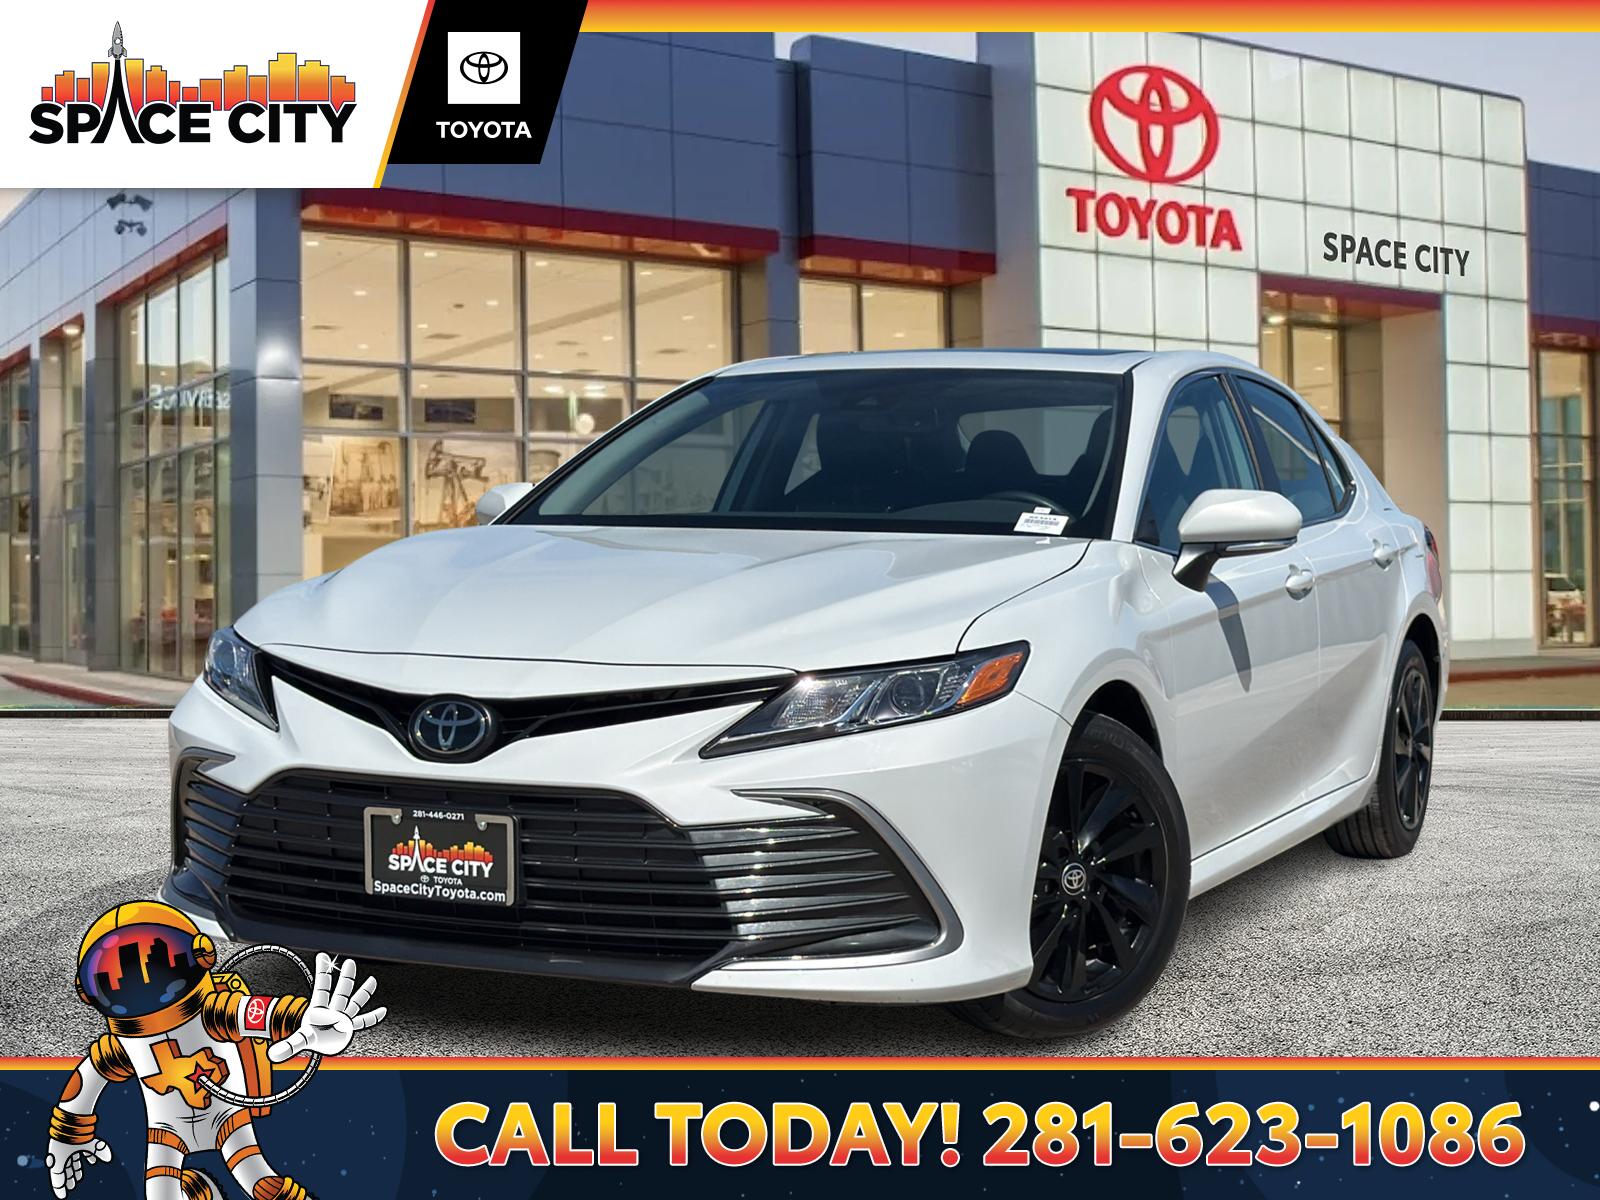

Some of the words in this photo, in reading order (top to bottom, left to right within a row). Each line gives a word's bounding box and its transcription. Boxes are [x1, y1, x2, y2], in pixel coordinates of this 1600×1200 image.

[1066, 188, 1242, 252] TOYOTA
[1323, 232, 1407, 271] SPACE
[1415, 244, 1470, 277] CITY
[412, 810, 465, 821] 281-446-0271
[388, 853, 448, 875] SPACE
[451, 858, 494, 878] CITY
[374, 880, 506, 903] SpaceCityToyota.com
[433, 875, 463, 886] TOYOTA
